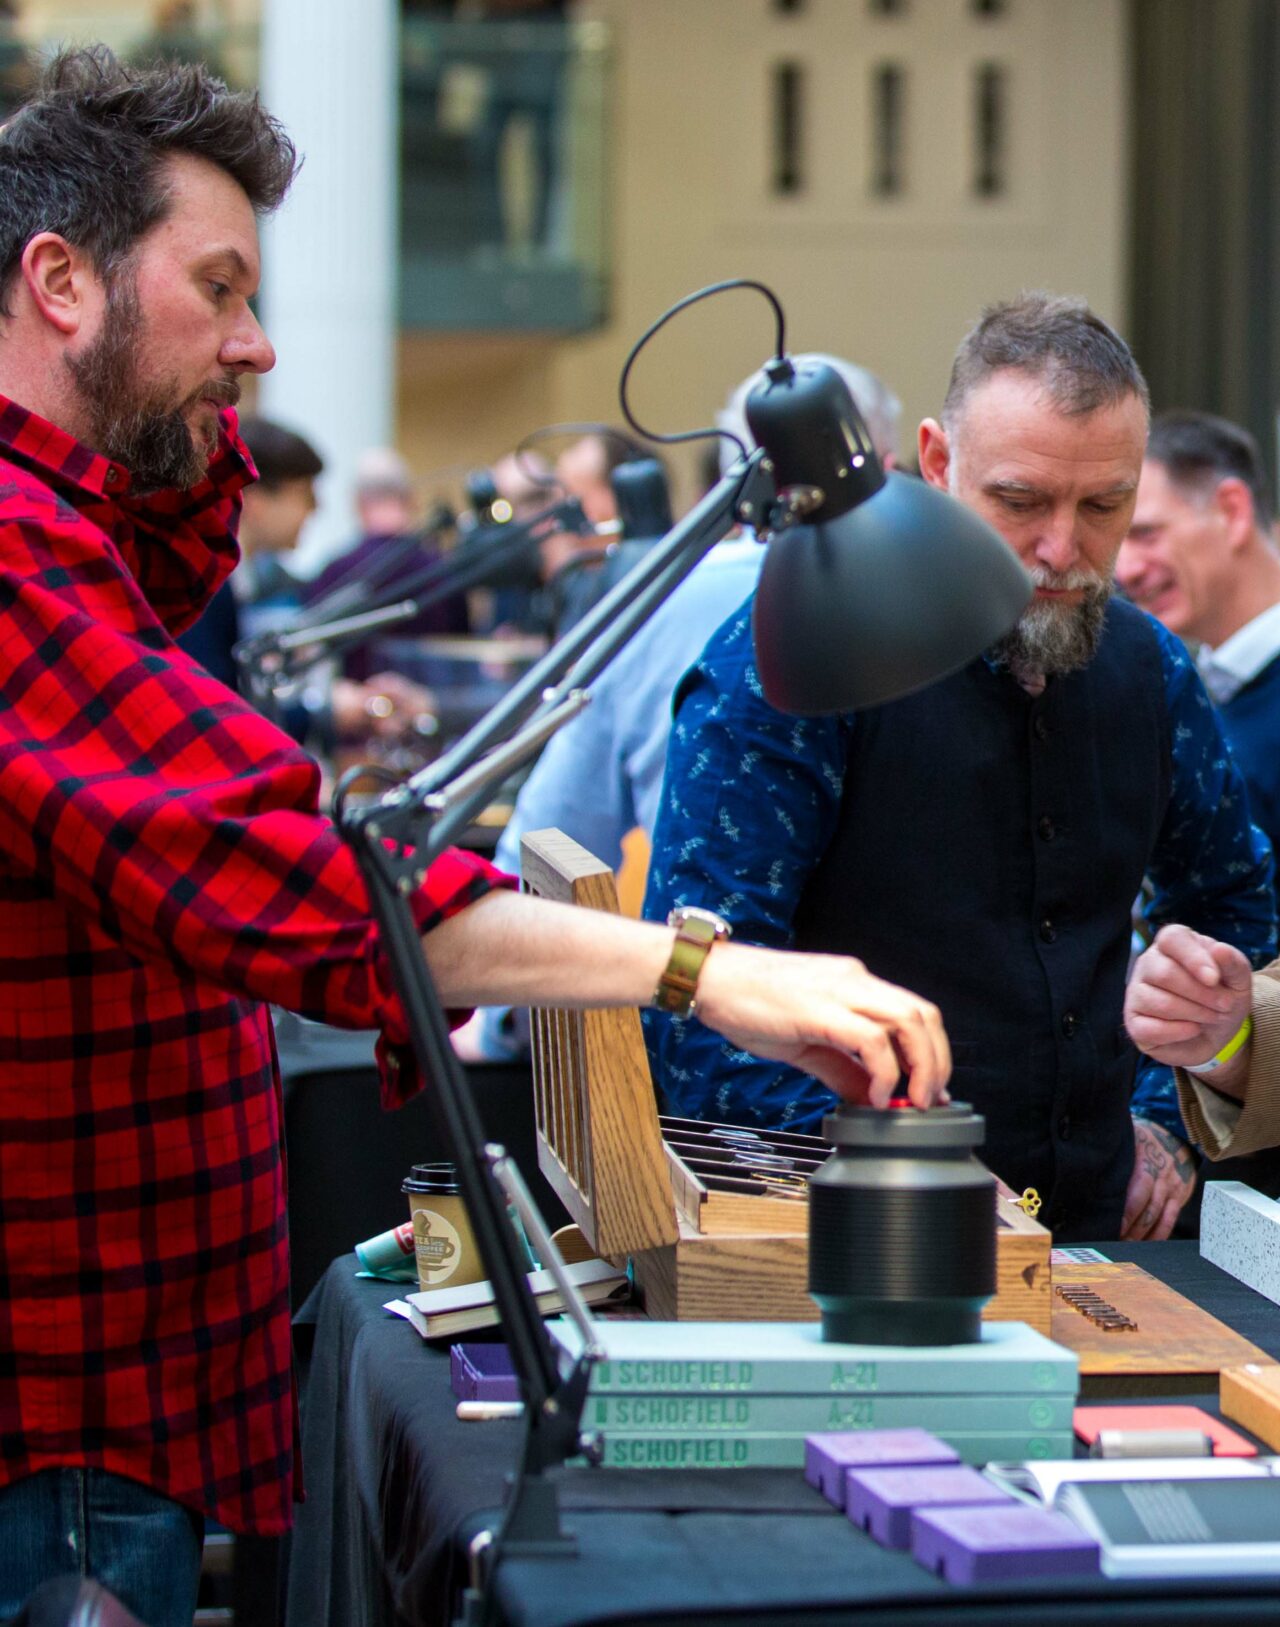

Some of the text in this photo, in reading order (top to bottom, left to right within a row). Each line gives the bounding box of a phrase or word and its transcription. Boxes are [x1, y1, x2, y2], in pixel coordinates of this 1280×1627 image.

[619, 1361, 877, 1388] SCHOFIELD A-21
[616, 1400, 873, 1427] SCHOFIELD A-21
[613, 1440, 747, 1465] SCHOFIELD
